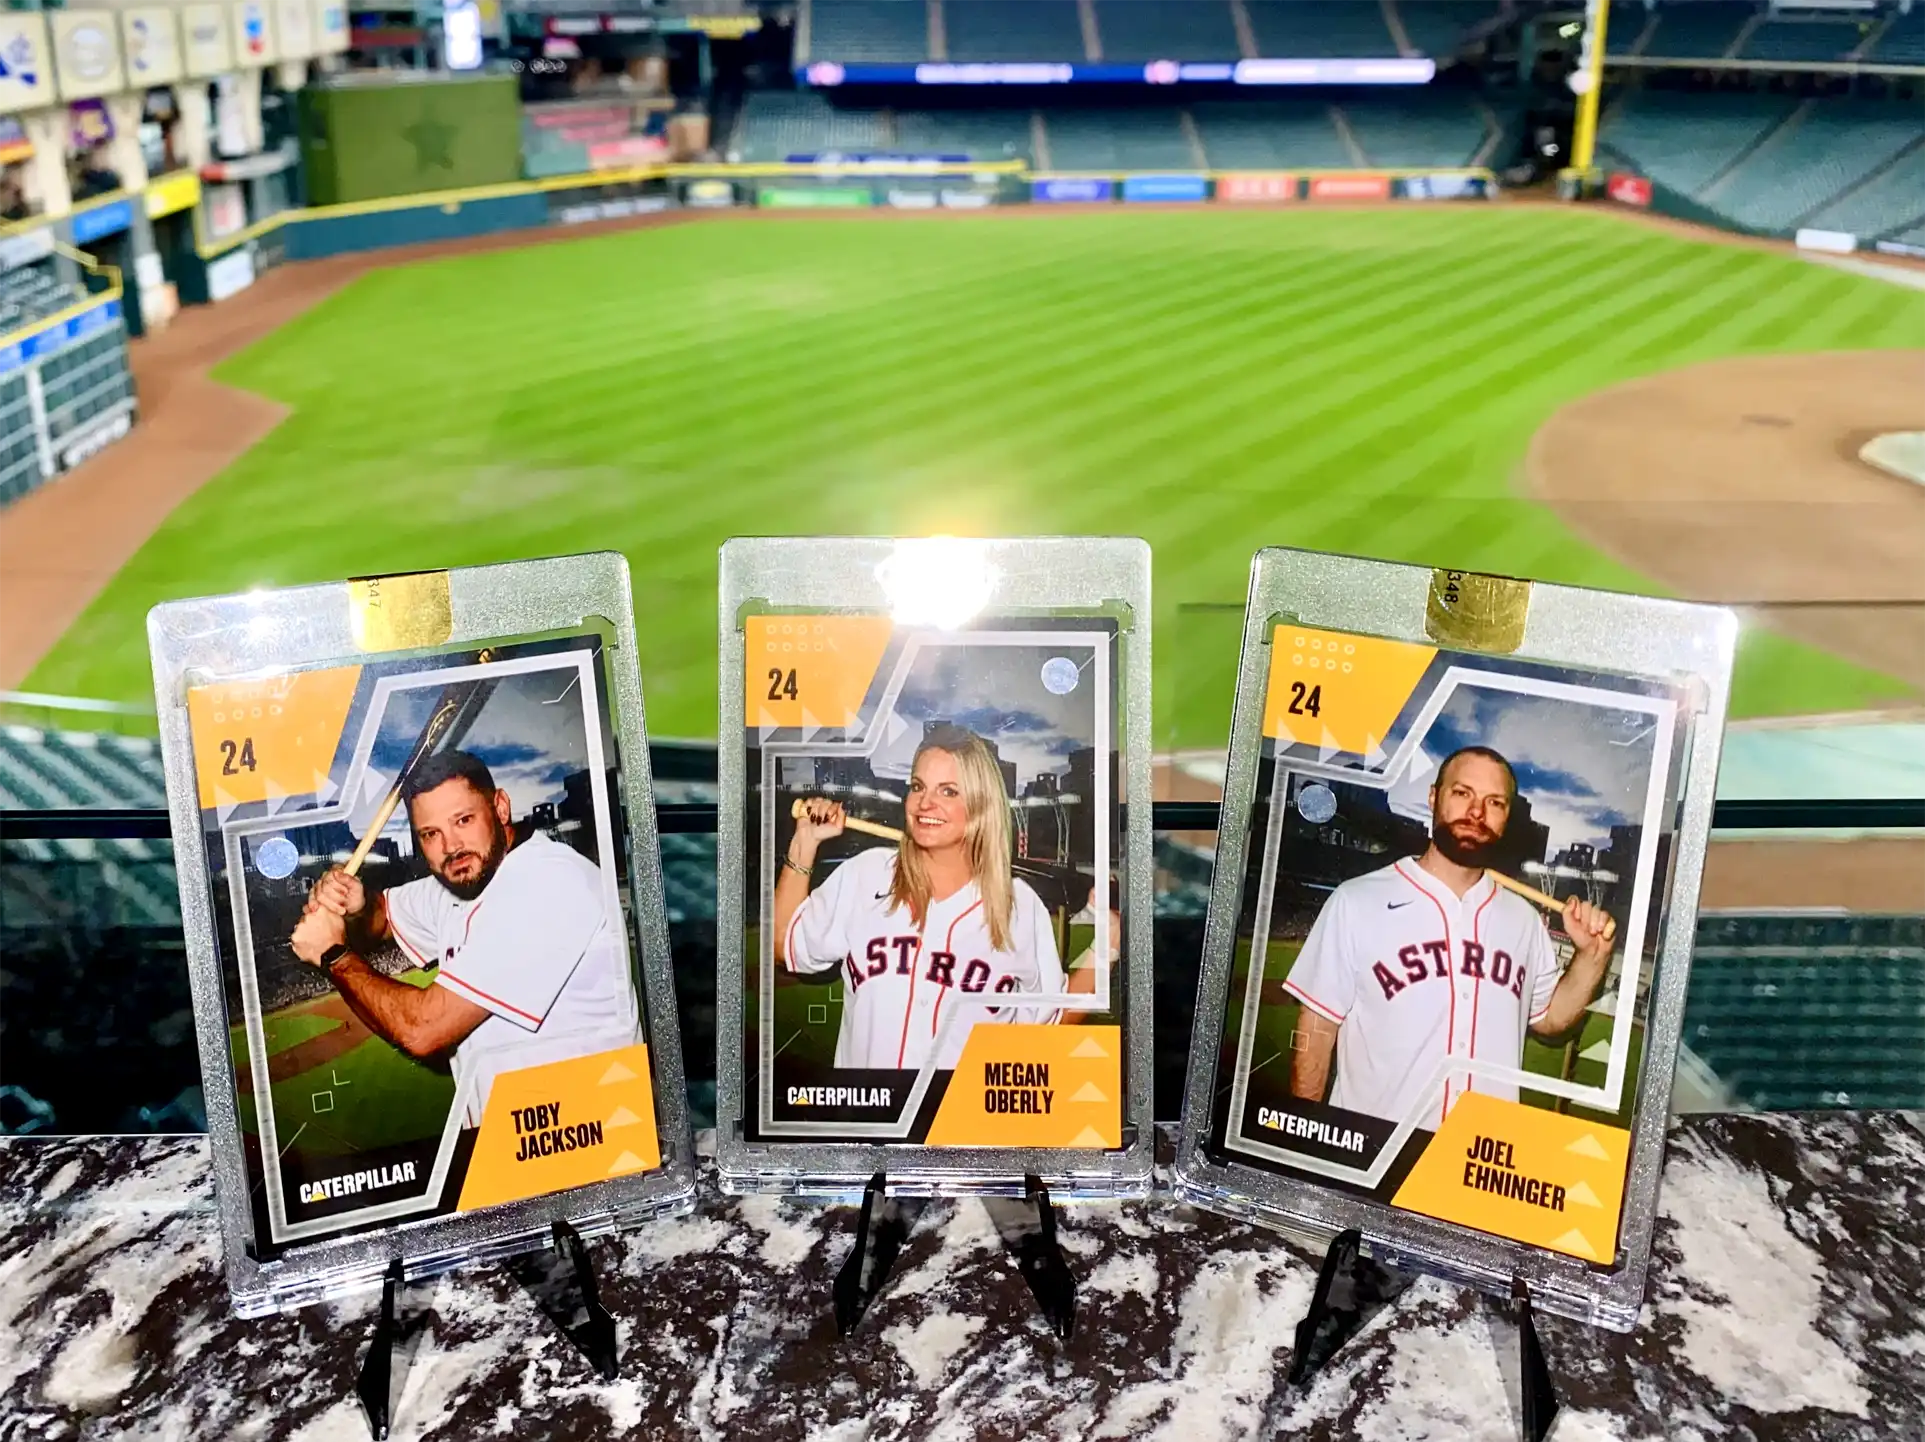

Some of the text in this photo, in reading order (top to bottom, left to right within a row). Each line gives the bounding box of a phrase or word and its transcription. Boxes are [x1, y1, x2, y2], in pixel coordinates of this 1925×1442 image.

[767, 668, 798, 701] 24
[1288, 682, 1321, 718] 24
[220, 738, 257, 776] 24
[1372, 939, 1526, 1001] ASTROS
[984, 1062, 1049, 1087] MEGAN
[786, 1086, 891, 1107] CATERPILLAR
[984, 1090, 1054, 1115] OBERLY
[510, 1102, 561, 1135] TOBY
[1257, 1106, 1365, 1153] CATERPILLAR
[515, 1121, 603, 1162] JACKSON
[1466, 1135, 1516, 1169] JOEL
[299, 1161, 416, 1204] CATERPILLAR
[1463, 1163, 1566, 1213] EHNINGER
